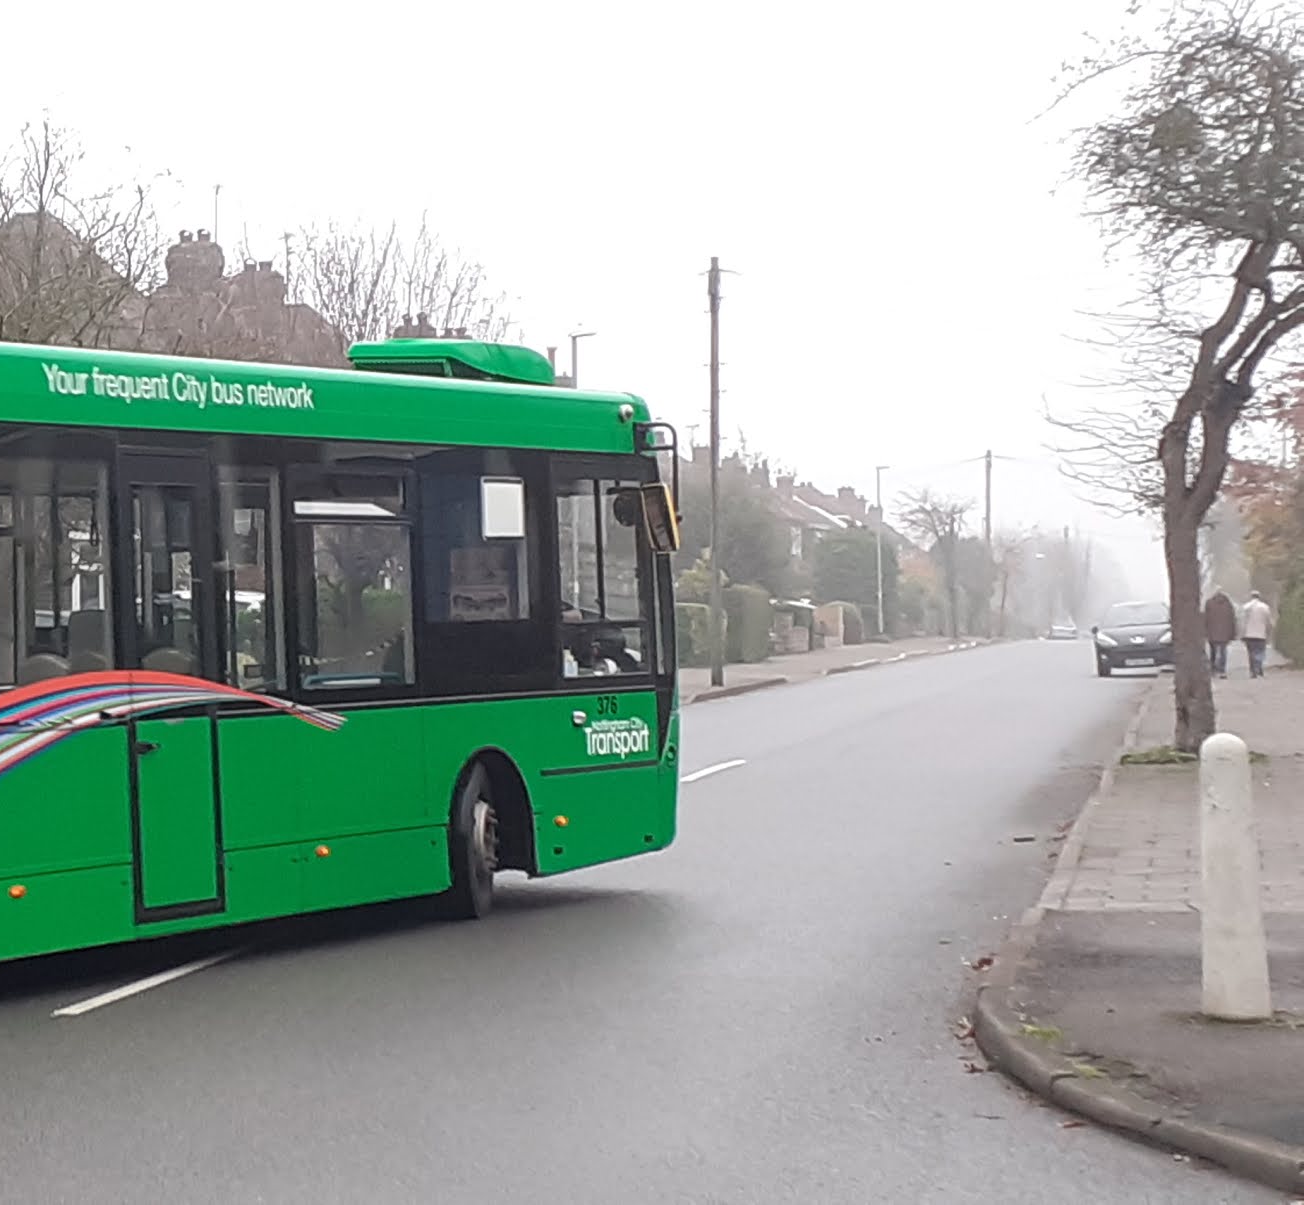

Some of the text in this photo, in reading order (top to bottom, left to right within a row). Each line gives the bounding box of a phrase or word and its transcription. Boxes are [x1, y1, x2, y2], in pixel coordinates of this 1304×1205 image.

[41, 361, 316, 410] Your frequent City bus network
[597, 695, 618, 715] 376
[583, 723, 650, 760] Transport
